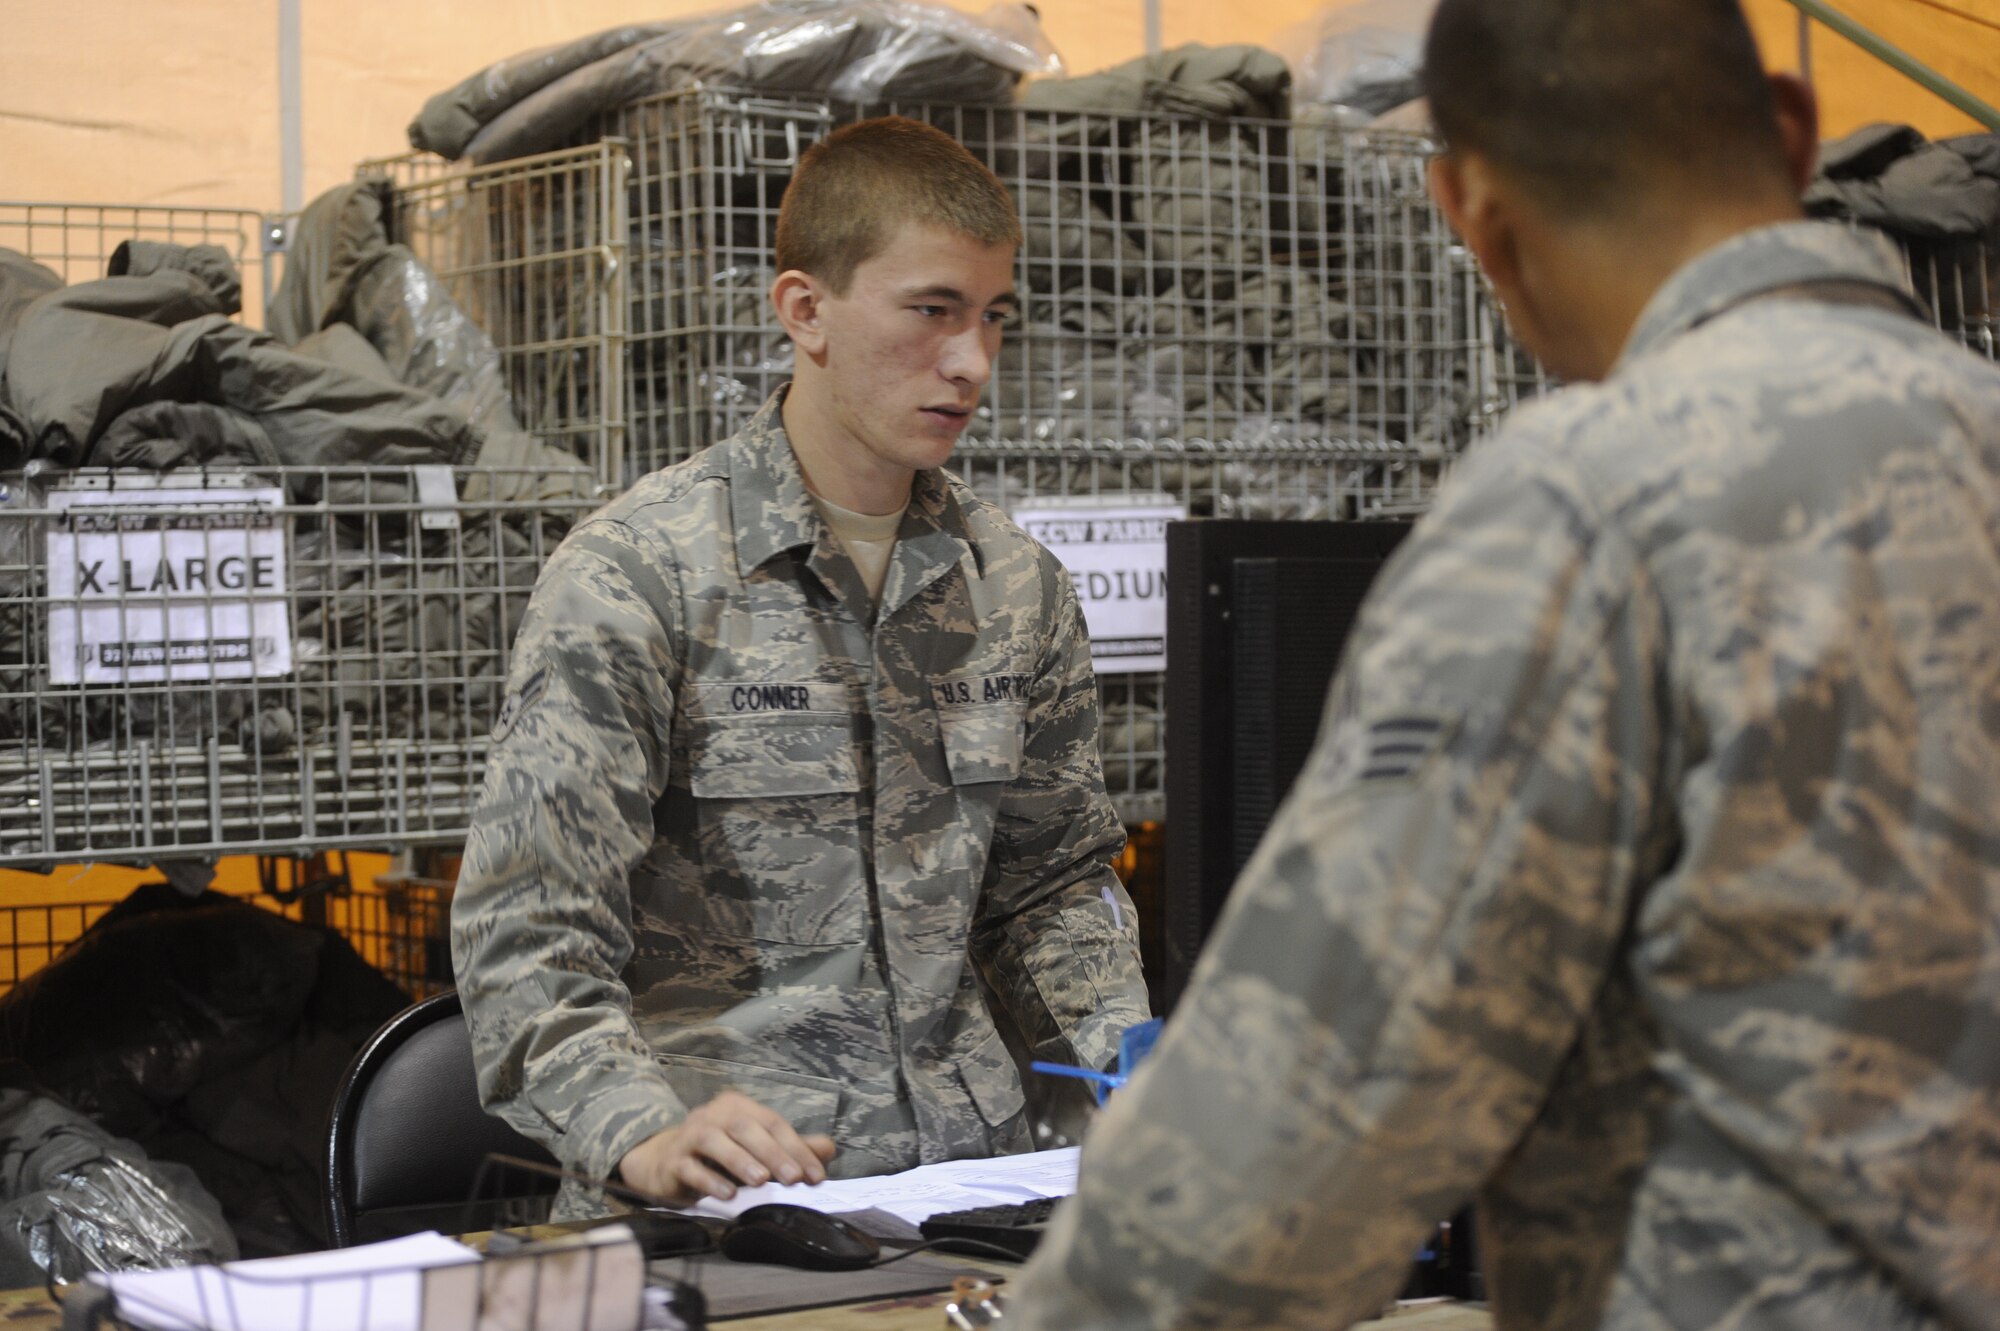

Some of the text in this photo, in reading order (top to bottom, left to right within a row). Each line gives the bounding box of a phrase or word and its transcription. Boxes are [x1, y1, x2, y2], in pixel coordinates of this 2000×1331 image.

[76, 556, 275, 594] X-LARGE
[1068, 570, 1167, 600] EDIU
[103, 648, 131, 663] 37
[732, 686, 810, 711] CONNER
[942, 681, 976, 703] U.S.
